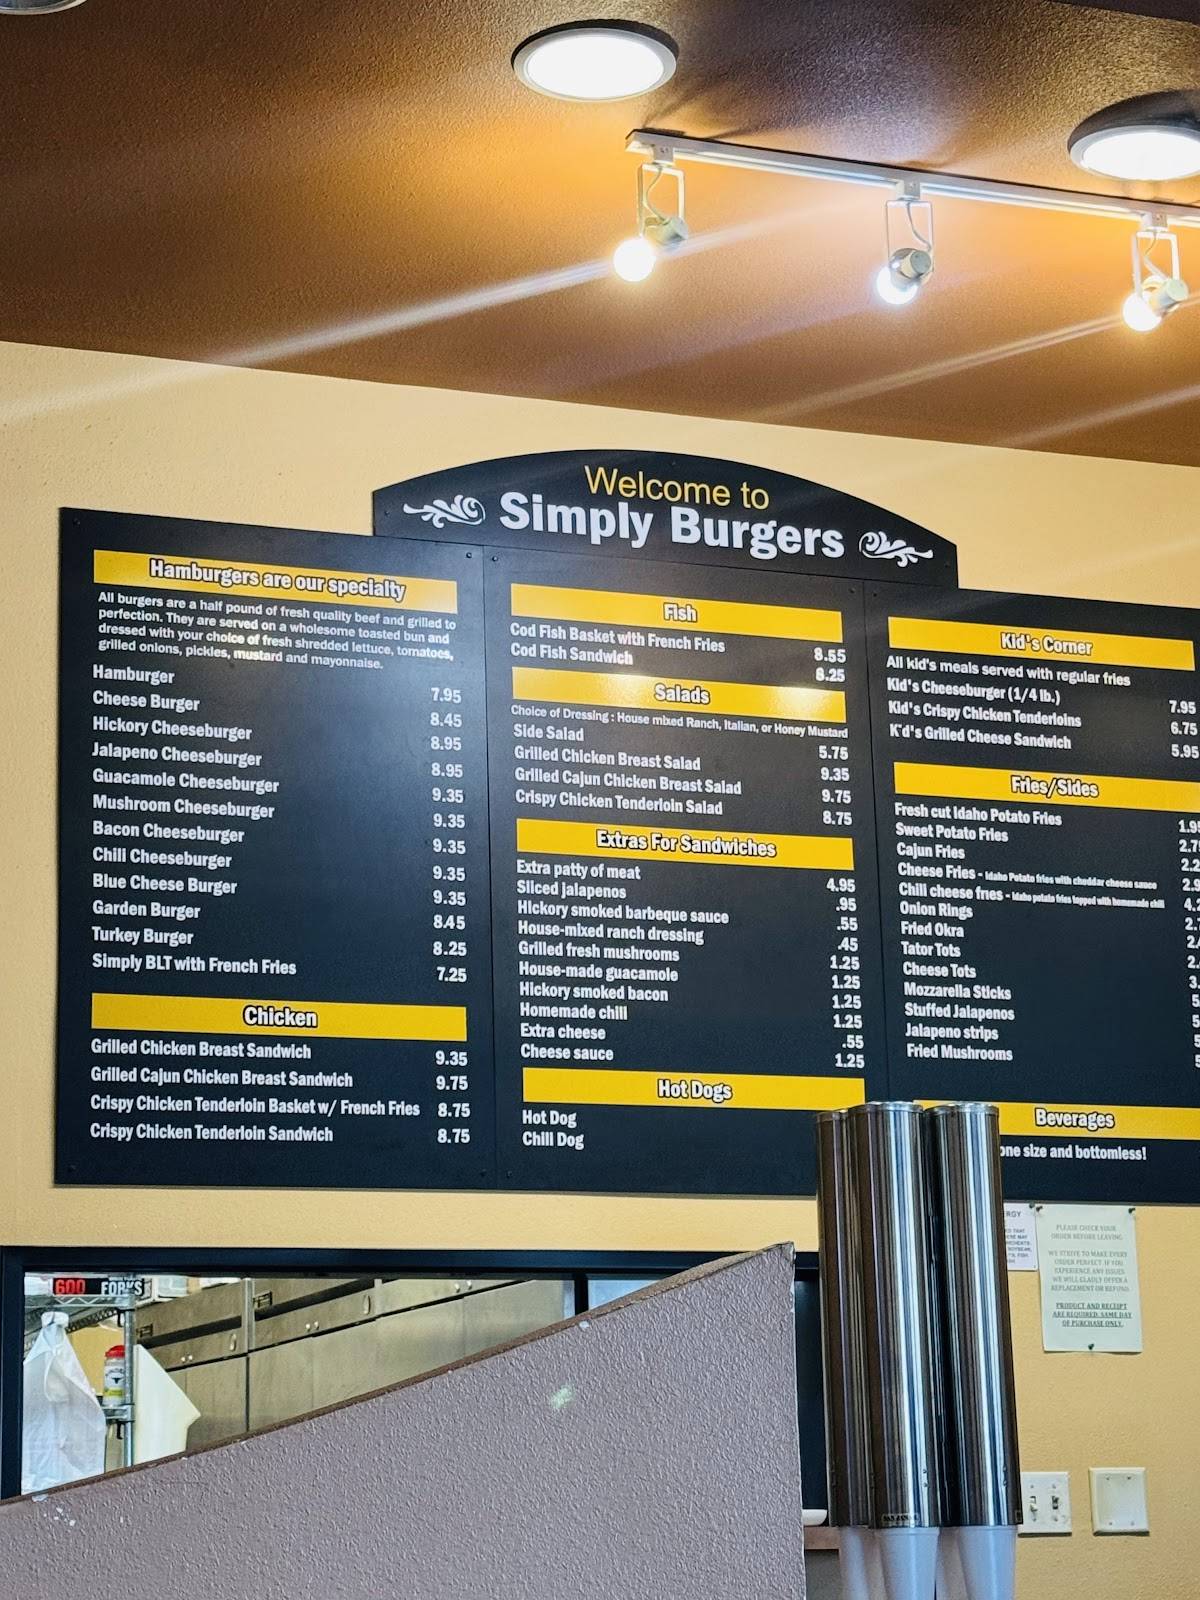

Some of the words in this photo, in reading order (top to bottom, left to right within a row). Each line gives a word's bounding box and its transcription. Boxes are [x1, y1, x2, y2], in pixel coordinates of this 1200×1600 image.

[584, 466, 730, 506] Welcome
[740, 482, 769, 510] to
[499, 492, 653, 548] Simply
[671, 506, 844, 560] Burgers
[152, 560, 258, 586] Hamburgers
[264, 574, 291, 587] are
[296, 577, 324, 590] our
[329, 580, 404, 601] specialty
[99, 592, 114, 602] All
[118, 593, 163, 607] burgers
[166, 600, 186, 608] are
[189, 601, 196, 609] a
[200, 600, 222, 611] half
[226, 604, 262, 614] pound
[266, 606, 277, 616] of
[280, 606, 310, 618] fresh
[313, 610, 352, 624] quality
[355, 612, 380, 624] beef
[382, 615, 405, 626] and
[407, 616, 442, 629] grilled
[444, 619, 457, 630] to
[665, 604, 696, 621] Fish
[510, 622, 536, 637] Cod
[539, 624, 566, 640] Fish
[569, 627, 616, 644] Basket
[617, 632, 645, 646] with
[648, 633, 691, 649] French
[694, 638, 725, 652] Fries
[1002, 634, 1039, 650] Kid's
[1044, 637, 1091, 654] Corner
[99, 640, 136, 651] grilled
[139, 642, 182, 656] onions,
[186, 645, 231, 659] pickles,
[233, 650, 283, 662] mustard
[286, 653, 308, 664] and
[311, 656, 385, 673] mayonnaise.
[814, 647, 846, 663] 8.55
[93, 664, 175, 686] Hamburger
[886, 655, 903, 668] All
[906, 657, 937, 671] kid's
[940, 662, 979, 674] meals
[982, 665, 1023, 678] served
[1026, 667, 1053, 680] with
[1056, 671, 1100, 685] regular
[1103, 672, 1131, 686] fries
[93, 690, 147, 707] Cheese
[150, 694, 200, 713] Burger
[431, 687, 461, 704] 7.95
[655, 684, 709, 704] Salads
[887, 677, 920, 692] Kid's
[921, 680, 1006, 701] Cheeseburger
[1008, 687, 1037, 703] (1/4
[1039, 689, 1060, 706] lb.)
[1169, 700, 1196, 714] 7.95
[430, 712, 462, 728] 8.45
[511, 705, 547, 717] Choice
[549, 708, 560, 718] of
[617, 712, 650, 724] House
[652, 715, 683, 726] mixed
[686, 717, 721, 731] Ranch,
[724, 720, 759, 733] Italian,
[774, 723, 806, 737] Honey
[808, 726, 848, 738] Mustard
[513, 724, 543, 738] Side
[546, 726, 584, 741] Salad
[92, 742, 158, 761] Jalapeno
[161, 746, 262, 768] Cheeseburger
[819, 746, 848, 760] 5.75
[431, 762, 463, 778] 8.95
[93, 768, 175, 787] Guacamole
[179, 773, 279, 795] Cheeseburger
[1012, 777, 1098, 797] Fries/Sides
[432, 788, 463, 803] 9.35
[93, 794, 171, 812] Mushroom
[174, 799, 275, 820] Cheeseburger
[895, 802, 929, 817] Fresh
[931, 806, 952, 819] cut
[953, 806, 988, 821] Idaho
[990, 808, 1030, 824] Potato
[1033, 811, 1062, 826] Fries
[433, 813, 465, 828] 9.35
[598, 831, 647, 848] Extras
[652, 834, 676, 850] For
[681, 836, 775, 856] Sandwiches
[517, 859, 551, 874] Extra
[554, 862, 588, 880] patty
[590, 864, 604, 878] of
[607, 866, 641, 879] meat
[827, 878, 855, 892] 4.95
[518, 900, 568, 919] Hickory
[571, 904, 622, 918] smoked
[625, 905, 687, 924] barbeque
[690, 912, 729, 924] sauce
[900, 901, 936, 916] Onion
[938, 903, 973, 920] Rings
[837, 917, 858, 931] .55
[92, 926, 140, 945] Turkey
[144, 928, 194, 947] Burger
[433, 941, 467, 956] 8.25
[92, 953, 142, 972] Simply
[146, 955, 172, 970] BLT
[174, 956, 205, 971] with
[209, 957, 258, 973] French
[262, 959, 297, 975] Fries
[437, 966, 467, 982] 7.25
[519, 961, 603, 978] House-made
[606, 967, 678, 982] guacamole
[832, 975, 860, 990] 1.25
[904, 982, 971, 998] Mozzarella
[973, 985, 1011, 1000] Sticks
[245, 1007, 316, 1026] Chicken
[907, 1043, 938, 1058] Fried
[941, 1044, 1013, 1061] Mushrooms
[91, 1066, 137, 1082] Grilled
[140, 1068, 180, 1086] Cajun
[183, 1069, 238, 1084] Chicken
[242, 1070, 287, 1086] Breast
[289, 1071, 353, 1087] Sandwich
[436, 1076, 468, 1090] 9.75
[659, 1080, 690, 1097] Hot
[692, 1081, 731, 1102] Dogs
[91, 1094, 134, 1113] Crispy
[136, 1096, 192, 1111] Chicken
[194, 1097, 265, 1112] Tenderloin
[269, 1098, 316, 1114] Basket
[317, 1100, 337, 1117] w/
[341, 1100, 385, 1115] French
[388, 1101, 420, 1116] Fries
[438, 1103, 470, 1118] 8.75
[522, 1110, 547, 1124] Hot
[550, 1111, 577, 1128] Dog
[1036, 1109, 1114, 1130] Beverages
[1023, 1144, 1047, 1158] size
[1050, 1144, 1073, 1158] and
[1075, 1145, 1146, 1160] bottomless!
[55, 1279, 86, 1295] 600
